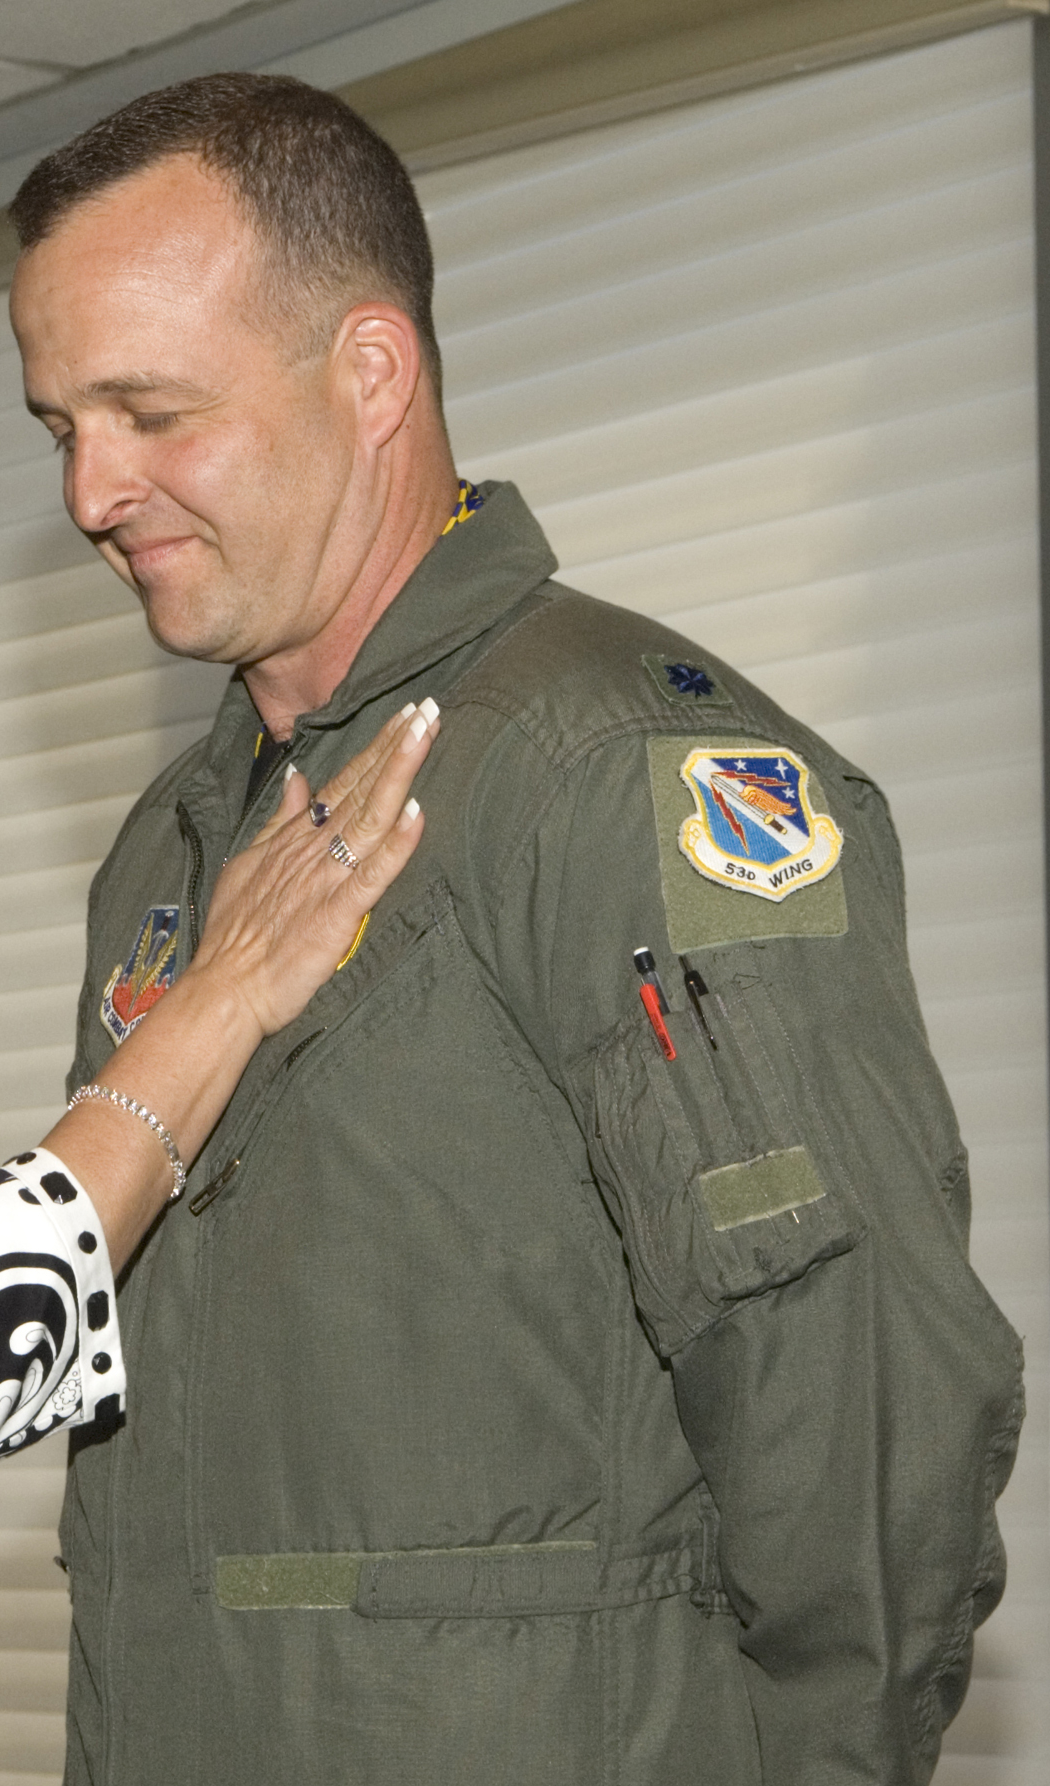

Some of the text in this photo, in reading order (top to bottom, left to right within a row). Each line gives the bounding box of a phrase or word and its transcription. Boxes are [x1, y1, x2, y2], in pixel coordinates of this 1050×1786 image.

[725, 859, 813, 888] 53D WING
[104, 997, 112, 1017] AIR
[107, 1011, 128, 1041] COMBAT
